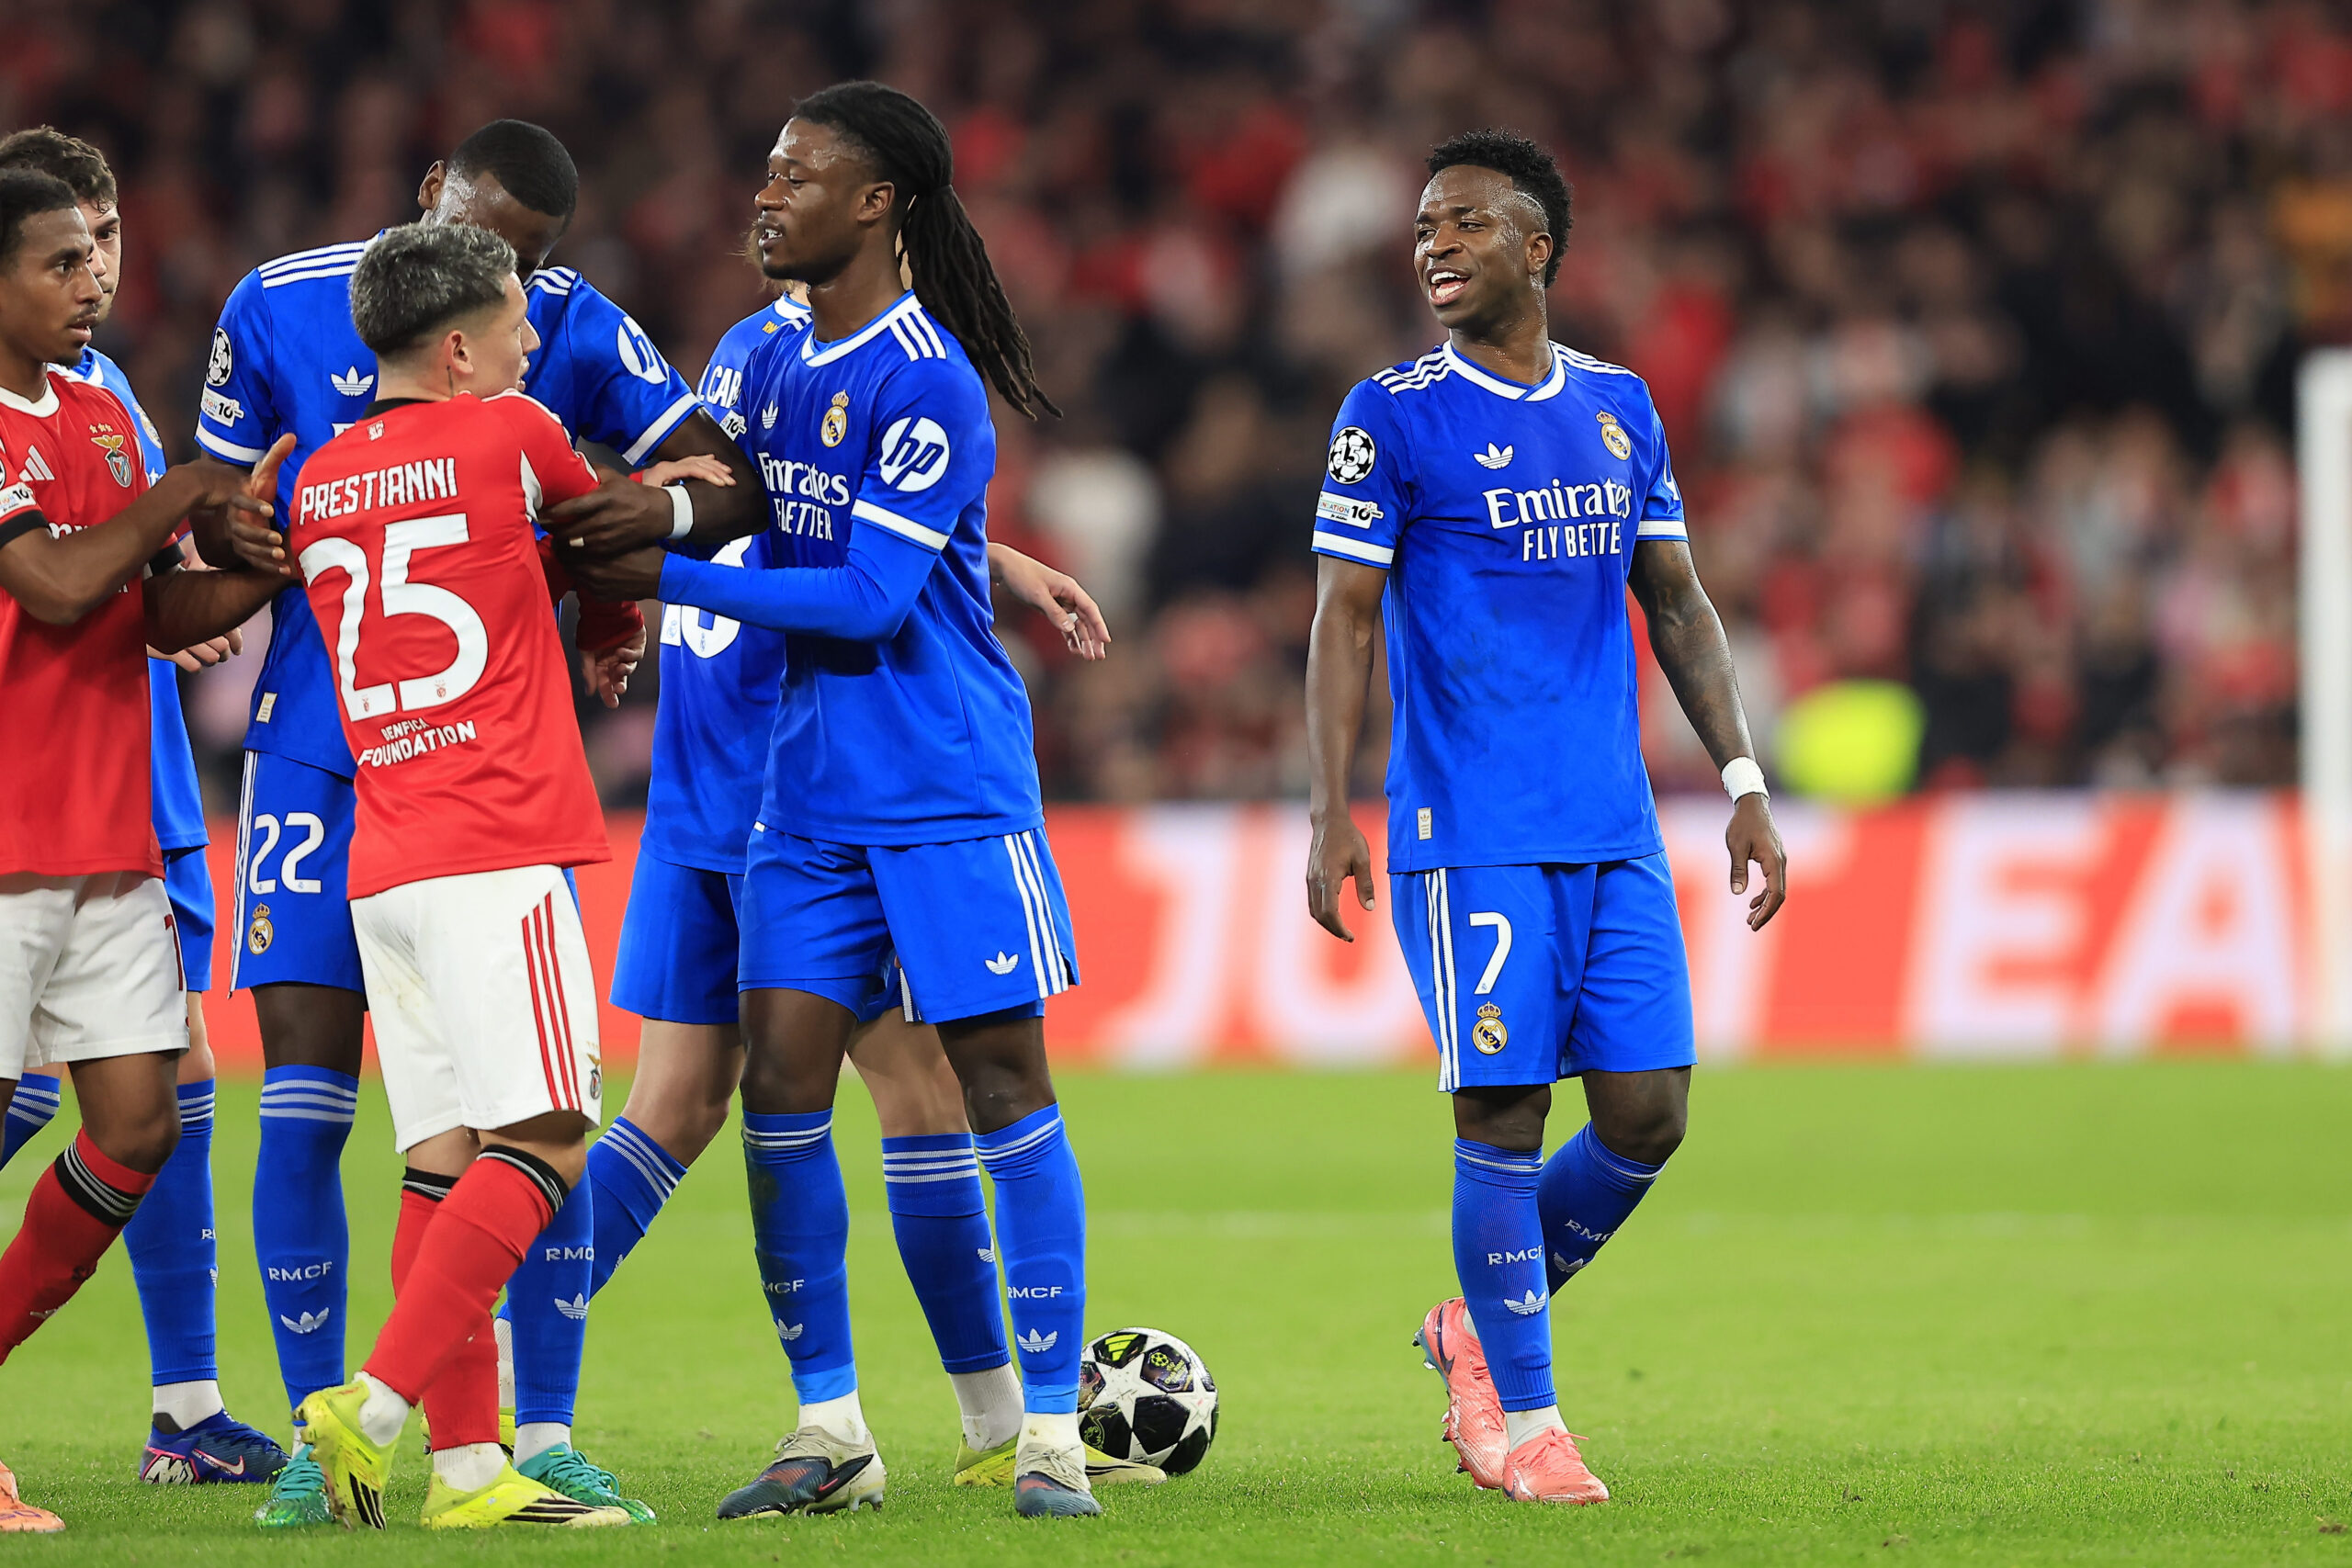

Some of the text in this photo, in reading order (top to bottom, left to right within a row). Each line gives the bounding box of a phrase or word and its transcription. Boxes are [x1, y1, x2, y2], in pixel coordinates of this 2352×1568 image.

[882, 416, 946, 491] hp
[1337, 443, 1362, 467] 15
[300, 457, 458, 526] PRESTIANNI
[1351, 505, 1371, 521] 10
[1482, 478, 1633, 530] Emirates
[1522, 522, 1622, 562] FLY BETTE
[298, 513, 489, 723] 25
[356, 720, 477, 768] FOUNDATION
[380, 717, 430, 742] BENFICA
[249, 812, 324, 895] 22
[1098, 797, 2299, 1067] JUT EA
[1469, 911, 1513, 995] 7
[268, 1261, 333, 1281] RMCF
[762, 1279, 805, 1294] MCF
[1007, 1286, 1063, 1299] RMCF
